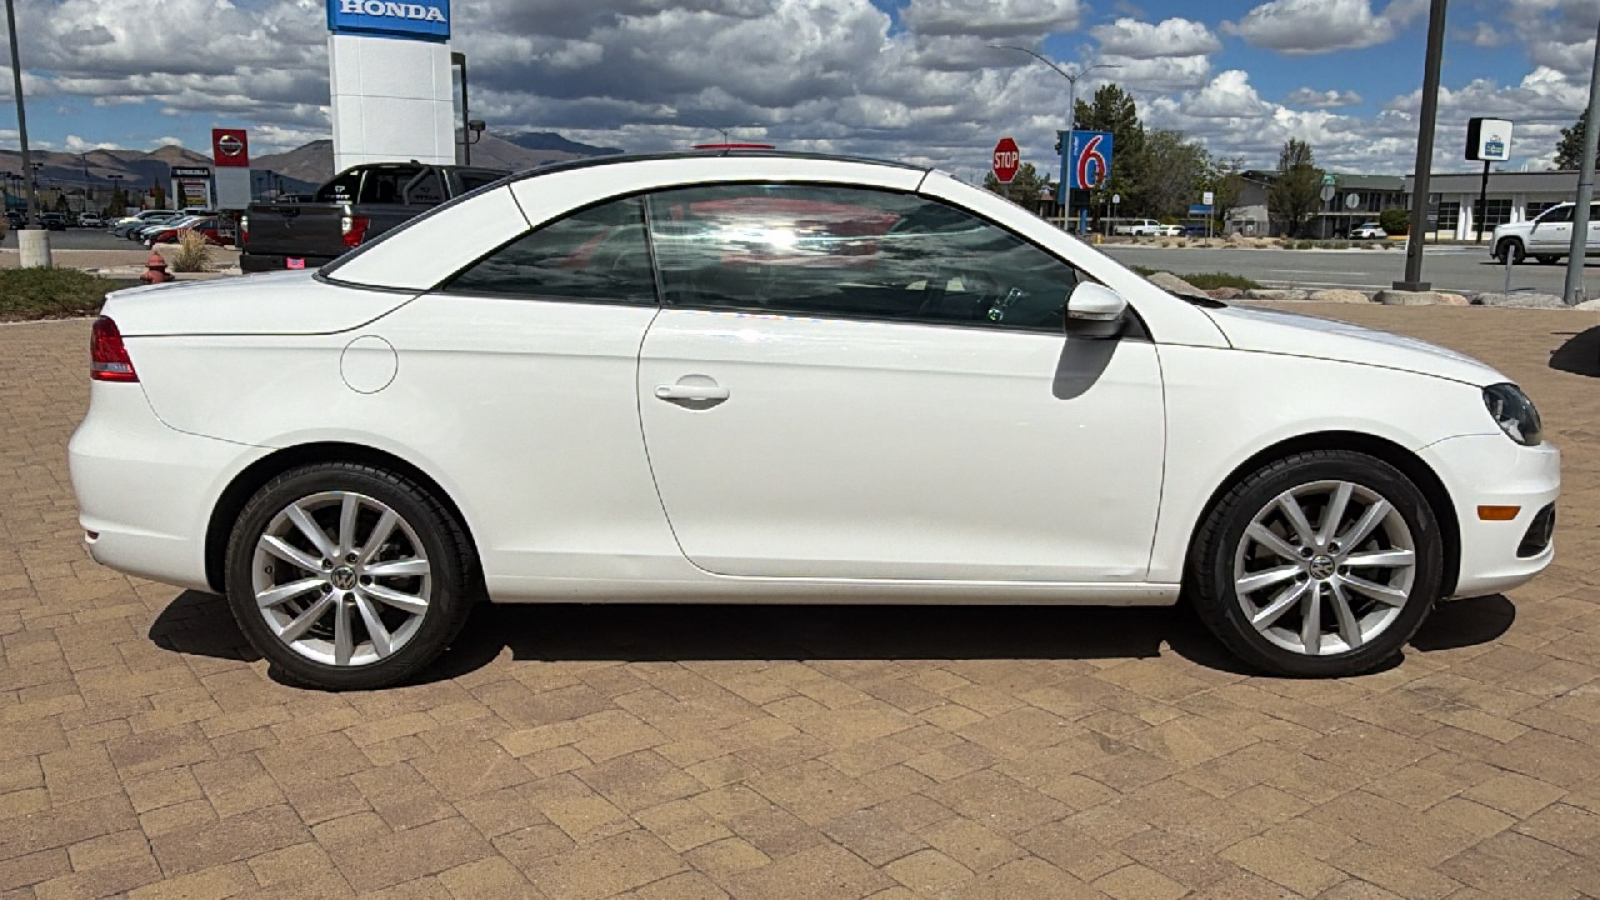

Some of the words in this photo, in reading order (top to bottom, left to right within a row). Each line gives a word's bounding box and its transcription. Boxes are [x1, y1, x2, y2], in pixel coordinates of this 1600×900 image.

[340, 0, 447, 21] HONDA
[994, 152, 1018, 169] STOP
[1076, 135, 1107, 190] 6
